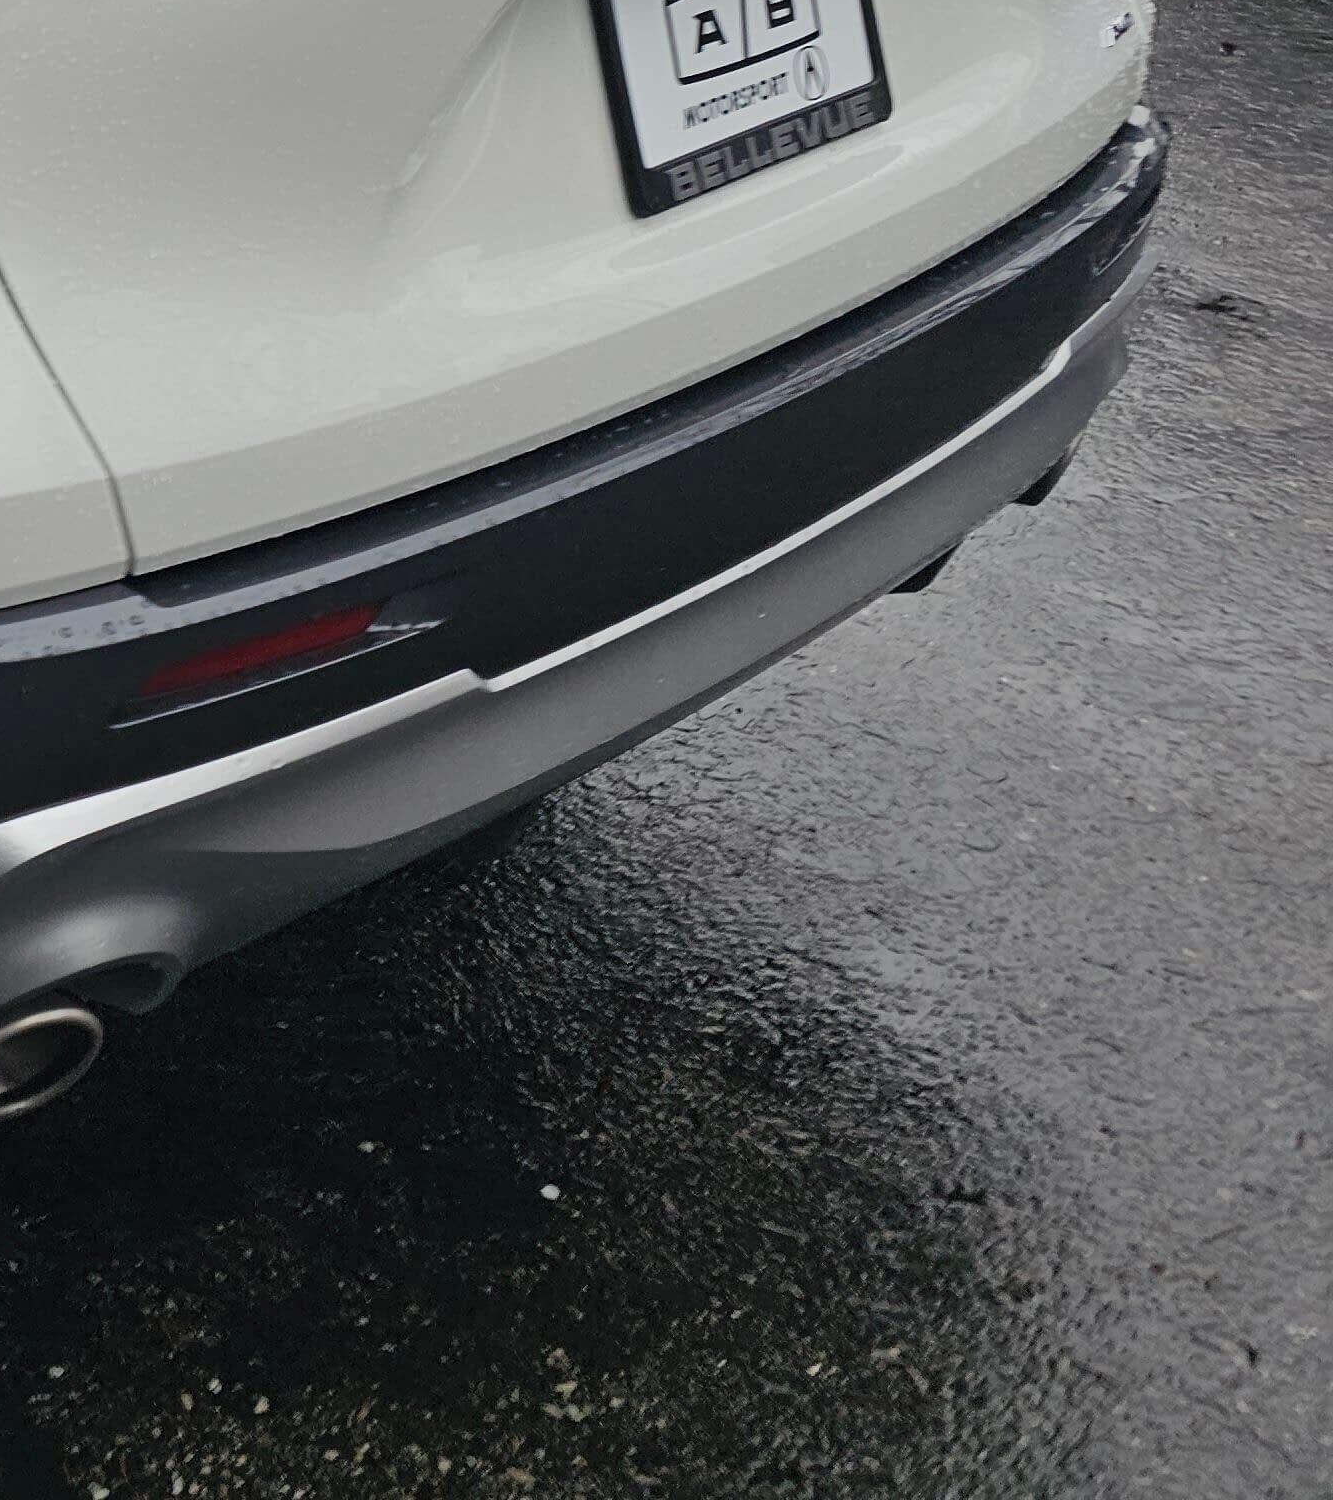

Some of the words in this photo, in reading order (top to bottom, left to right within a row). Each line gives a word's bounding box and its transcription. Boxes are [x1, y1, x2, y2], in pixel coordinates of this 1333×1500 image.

[693, 9, 728, 54] A
[682, 71, 791, 129] MOTORSPORT
[667, 93, 877, 202] BELLEVUE
